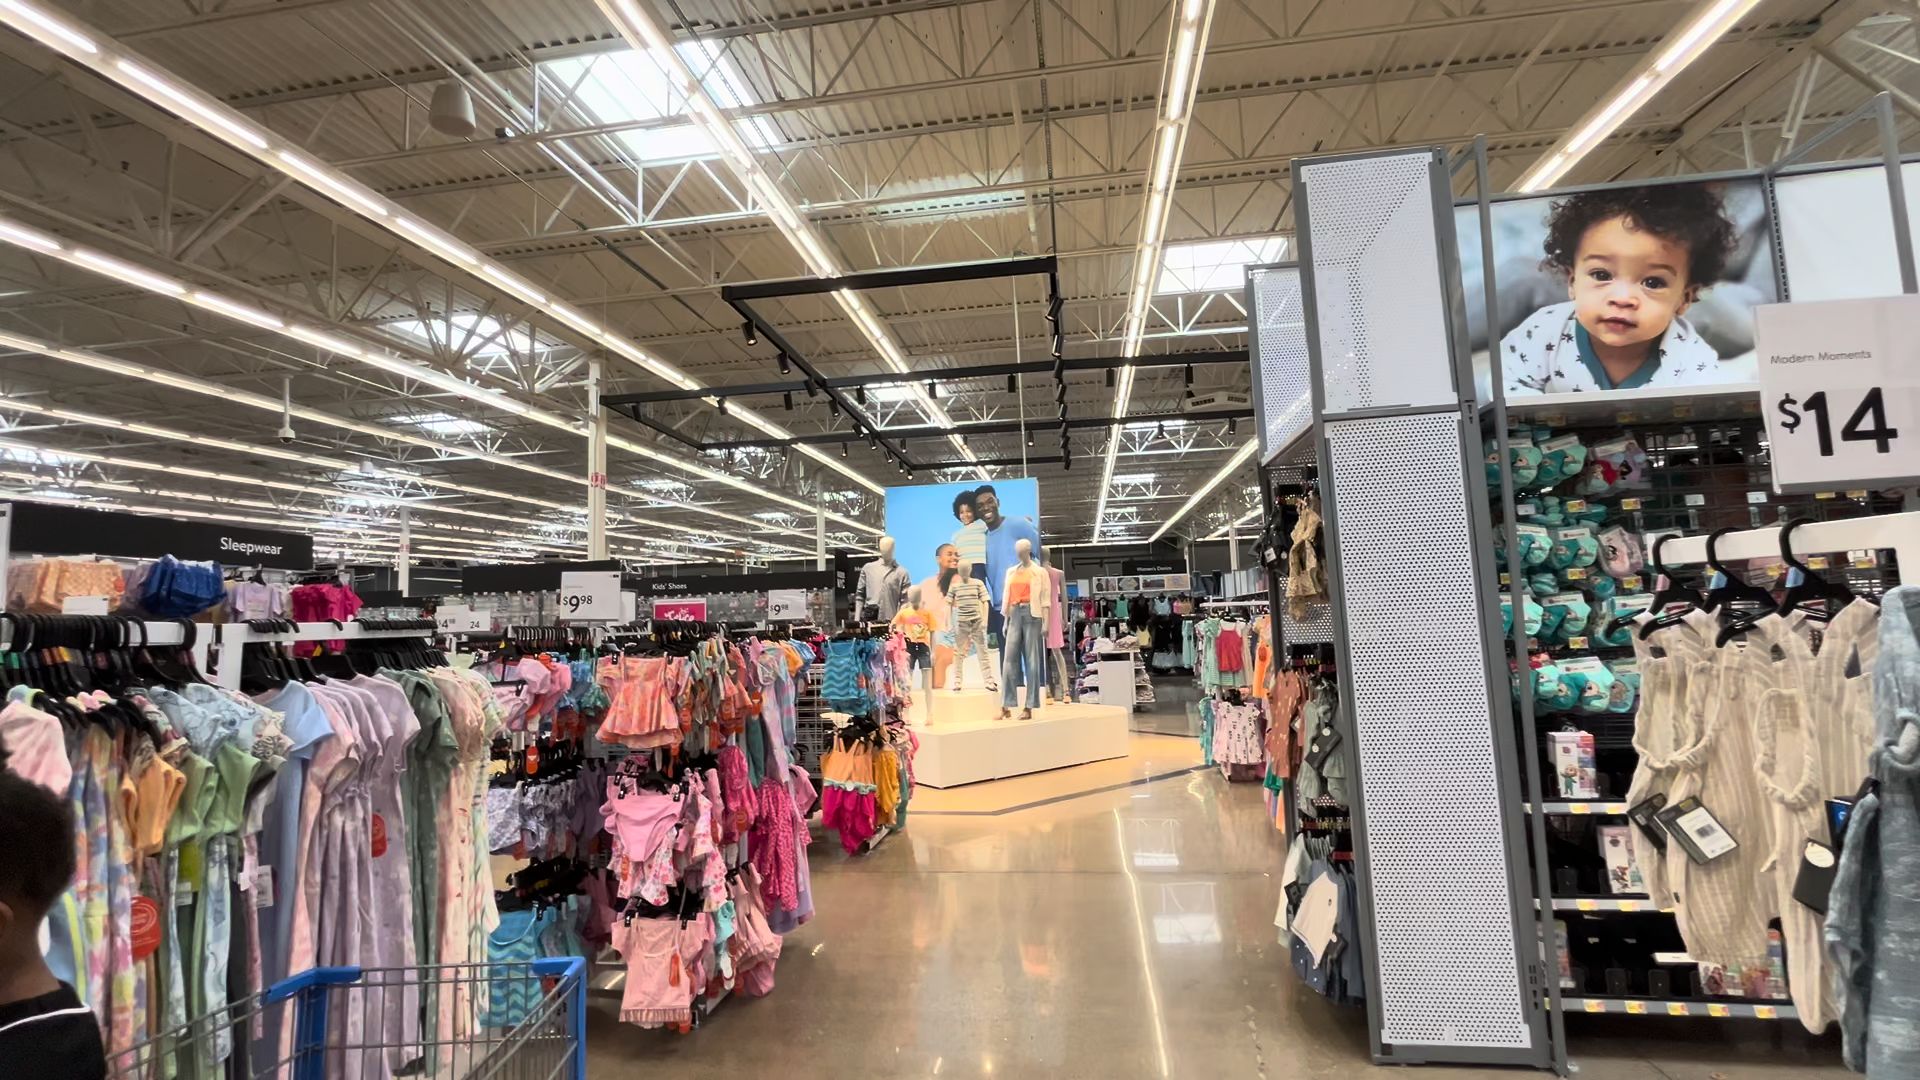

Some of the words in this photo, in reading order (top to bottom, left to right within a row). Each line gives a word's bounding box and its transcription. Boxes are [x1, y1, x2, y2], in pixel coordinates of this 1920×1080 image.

[1770, 354, 1815, 365] Modern
[1818, 350, 1872, 362] Moments
[1777, 386, 1899, 457] $14
[220, 536, 283, 556] Sleepwear
[668, 582, 688, 590] Shoes
